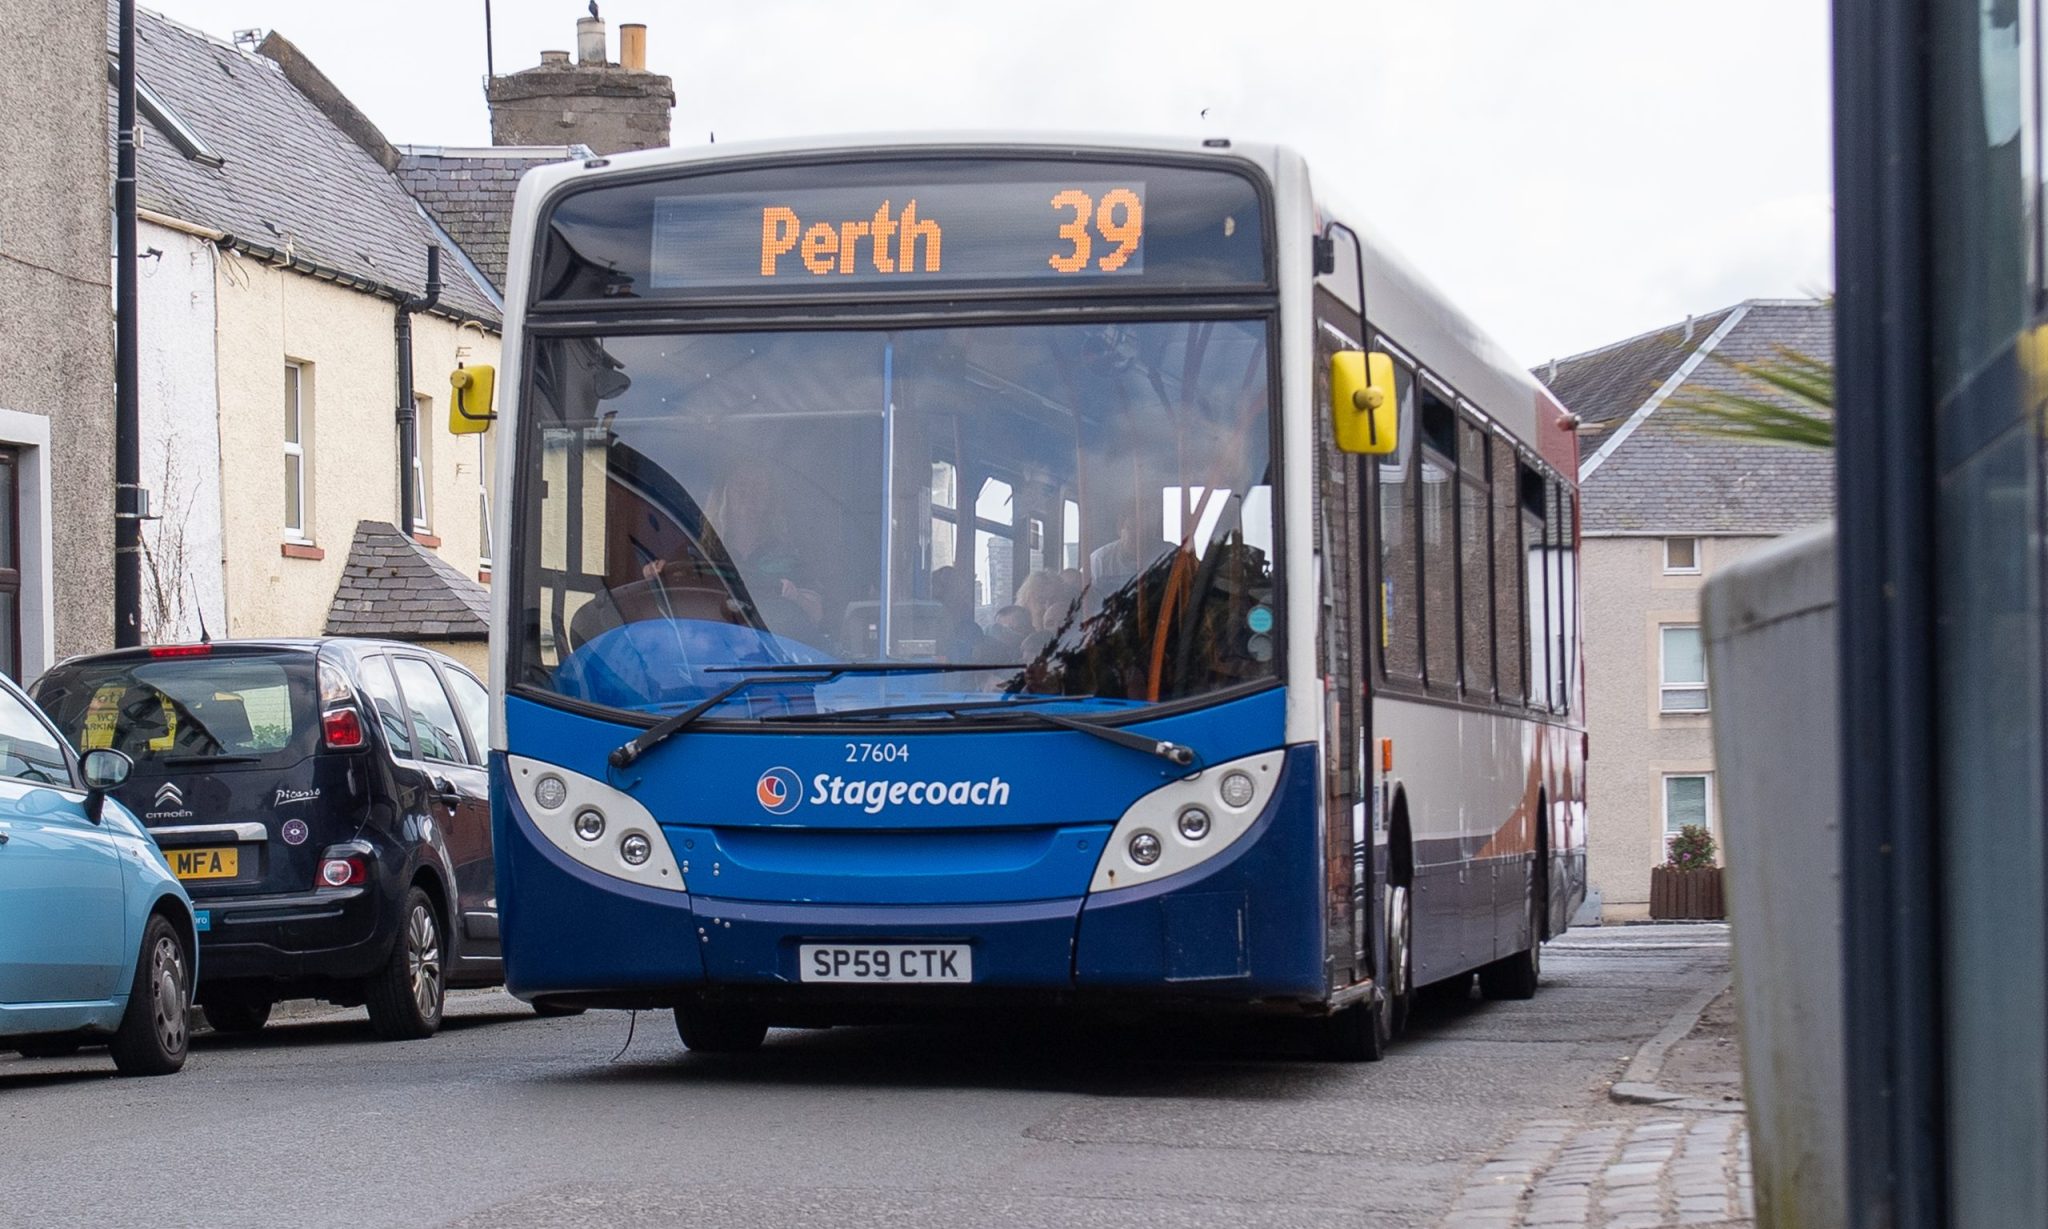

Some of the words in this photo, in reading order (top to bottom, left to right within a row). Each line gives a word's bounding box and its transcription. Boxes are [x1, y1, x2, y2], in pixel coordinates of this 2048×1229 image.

[761, 199, 941, 276] Perth
[1049, 188, 1143, 272] 39
[845, 743, 909, 762] 27604
[274, 787, 321, 807] Picasso
[810, 773, 1010, 814] Stagecoach
[177, 851, 223, 875] MFA
[813, 949, 891, 977] SP59
[900, 949, 958, 977] CTK
